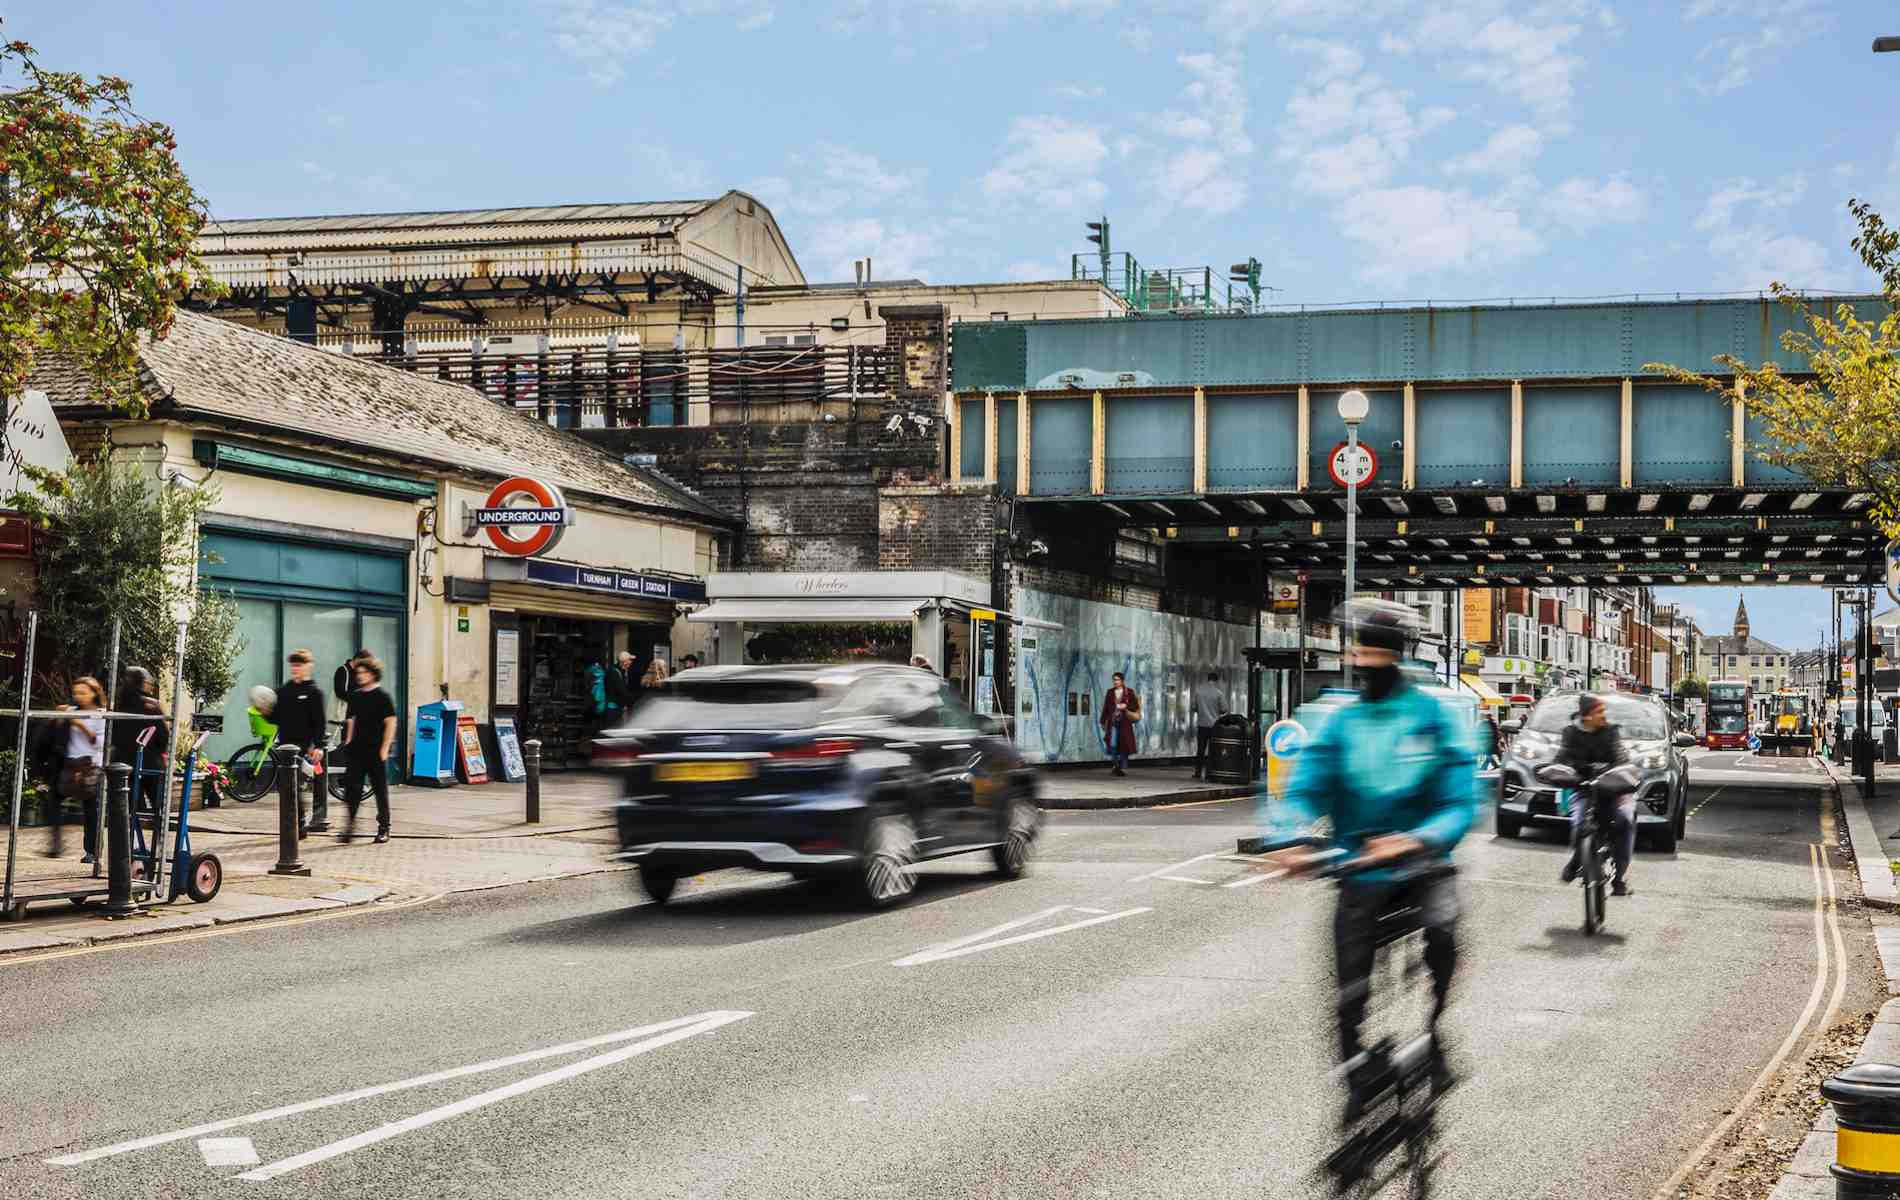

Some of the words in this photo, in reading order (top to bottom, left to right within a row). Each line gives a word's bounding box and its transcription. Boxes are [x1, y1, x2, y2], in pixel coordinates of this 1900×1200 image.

[478, 510, 561, 523] UNDERGROUND
[582, 572, 612, 587] TURNHAM
[620, 577, 639, 591] GREEN
[644, 581, 667, 594] STATION
